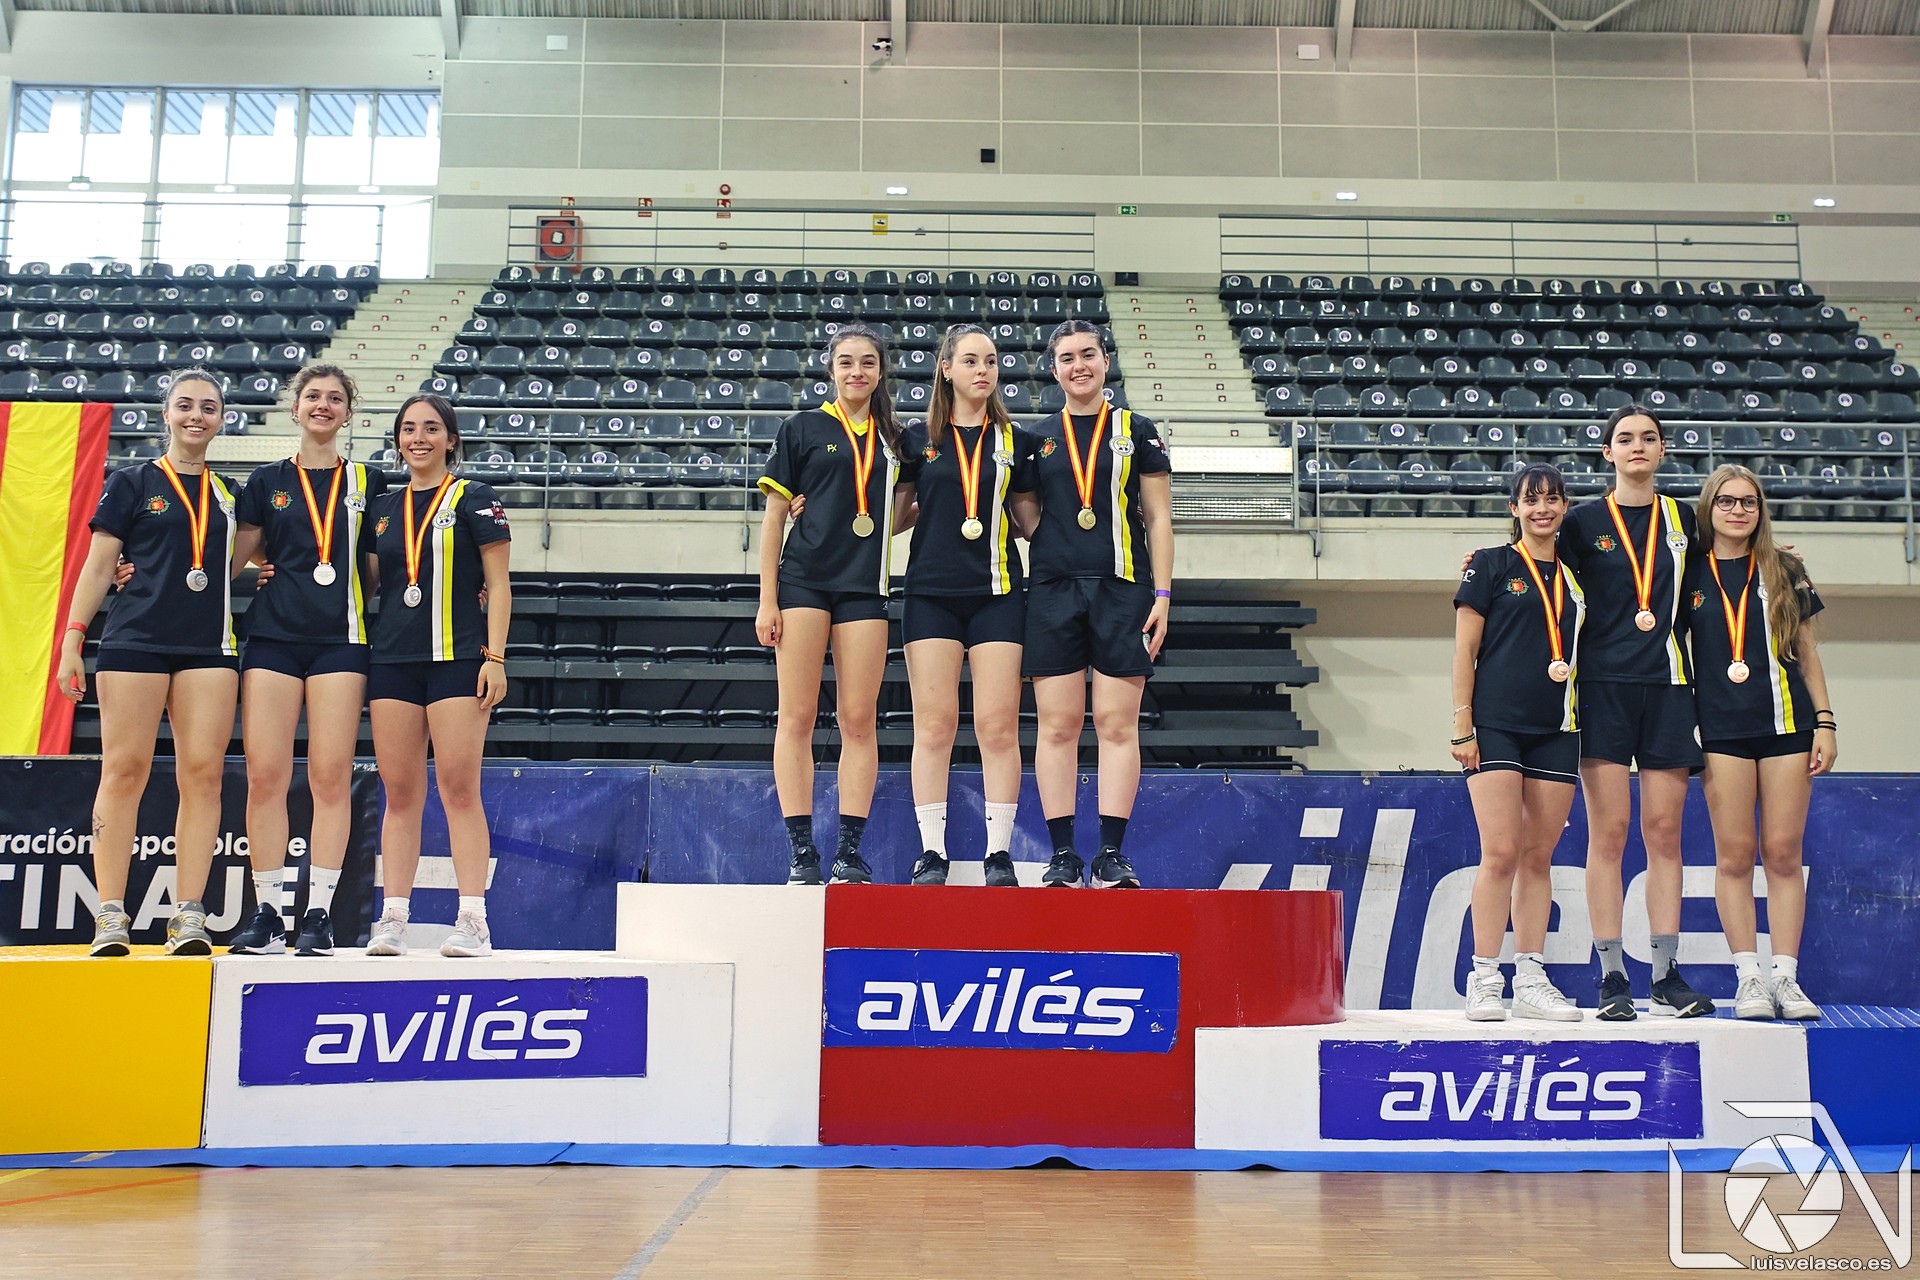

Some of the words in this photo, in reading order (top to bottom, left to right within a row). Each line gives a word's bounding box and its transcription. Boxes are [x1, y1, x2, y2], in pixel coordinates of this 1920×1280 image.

[305, 994, 589, 1065] avilés
[857, 967, 1145, 1037] avilés
[1379, 1054, 1647, 1122] avilés
